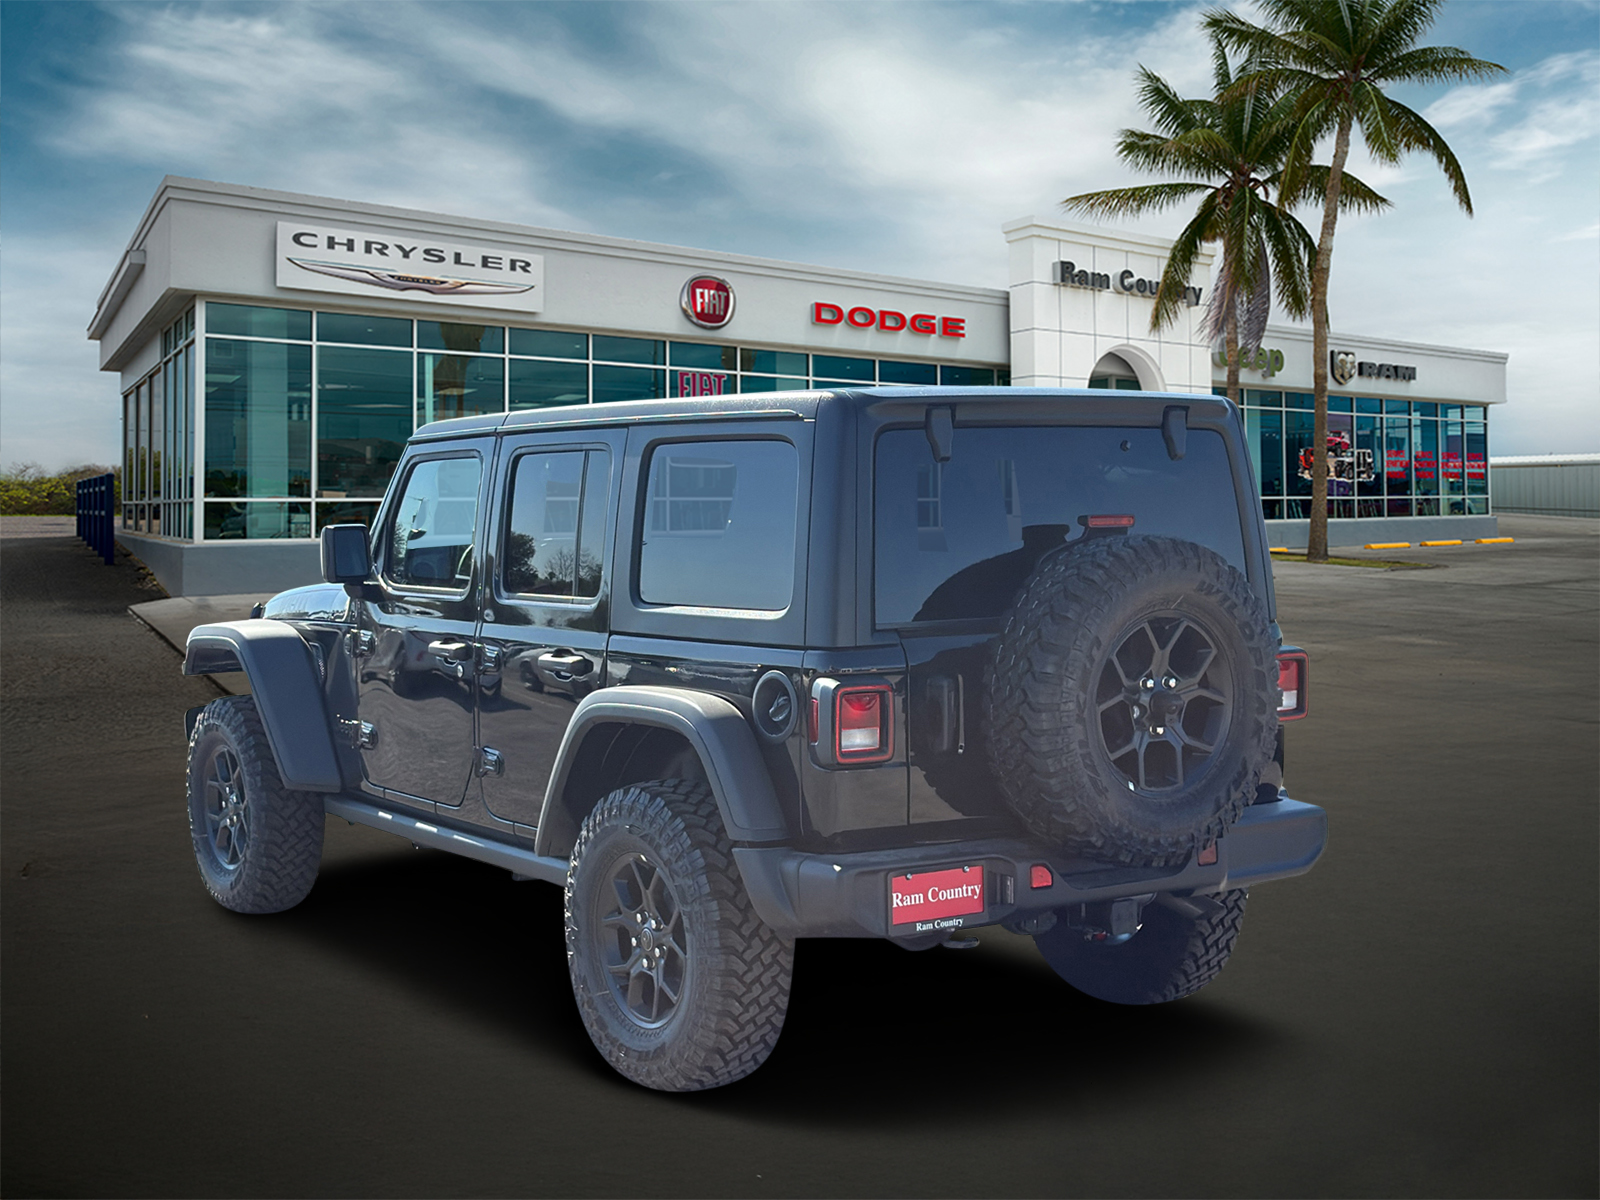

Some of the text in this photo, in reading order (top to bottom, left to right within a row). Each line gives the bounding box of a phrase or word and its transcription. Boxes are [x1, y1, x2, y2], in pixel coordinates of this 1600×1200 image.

[291, 232, 532, 273] CHRYSLER
[1054, 260, 1203, 306] Ram Coury
[695, 288, 727, 316] FIAT
[813, 301, 966, 338] DODGE
[678, 371, 726, 398] FIAT
[1358, 361, 1416, 381] RAM
[892, 884, 982, 908] Ram Country
[916, 918, 963, 931] Ram Country
